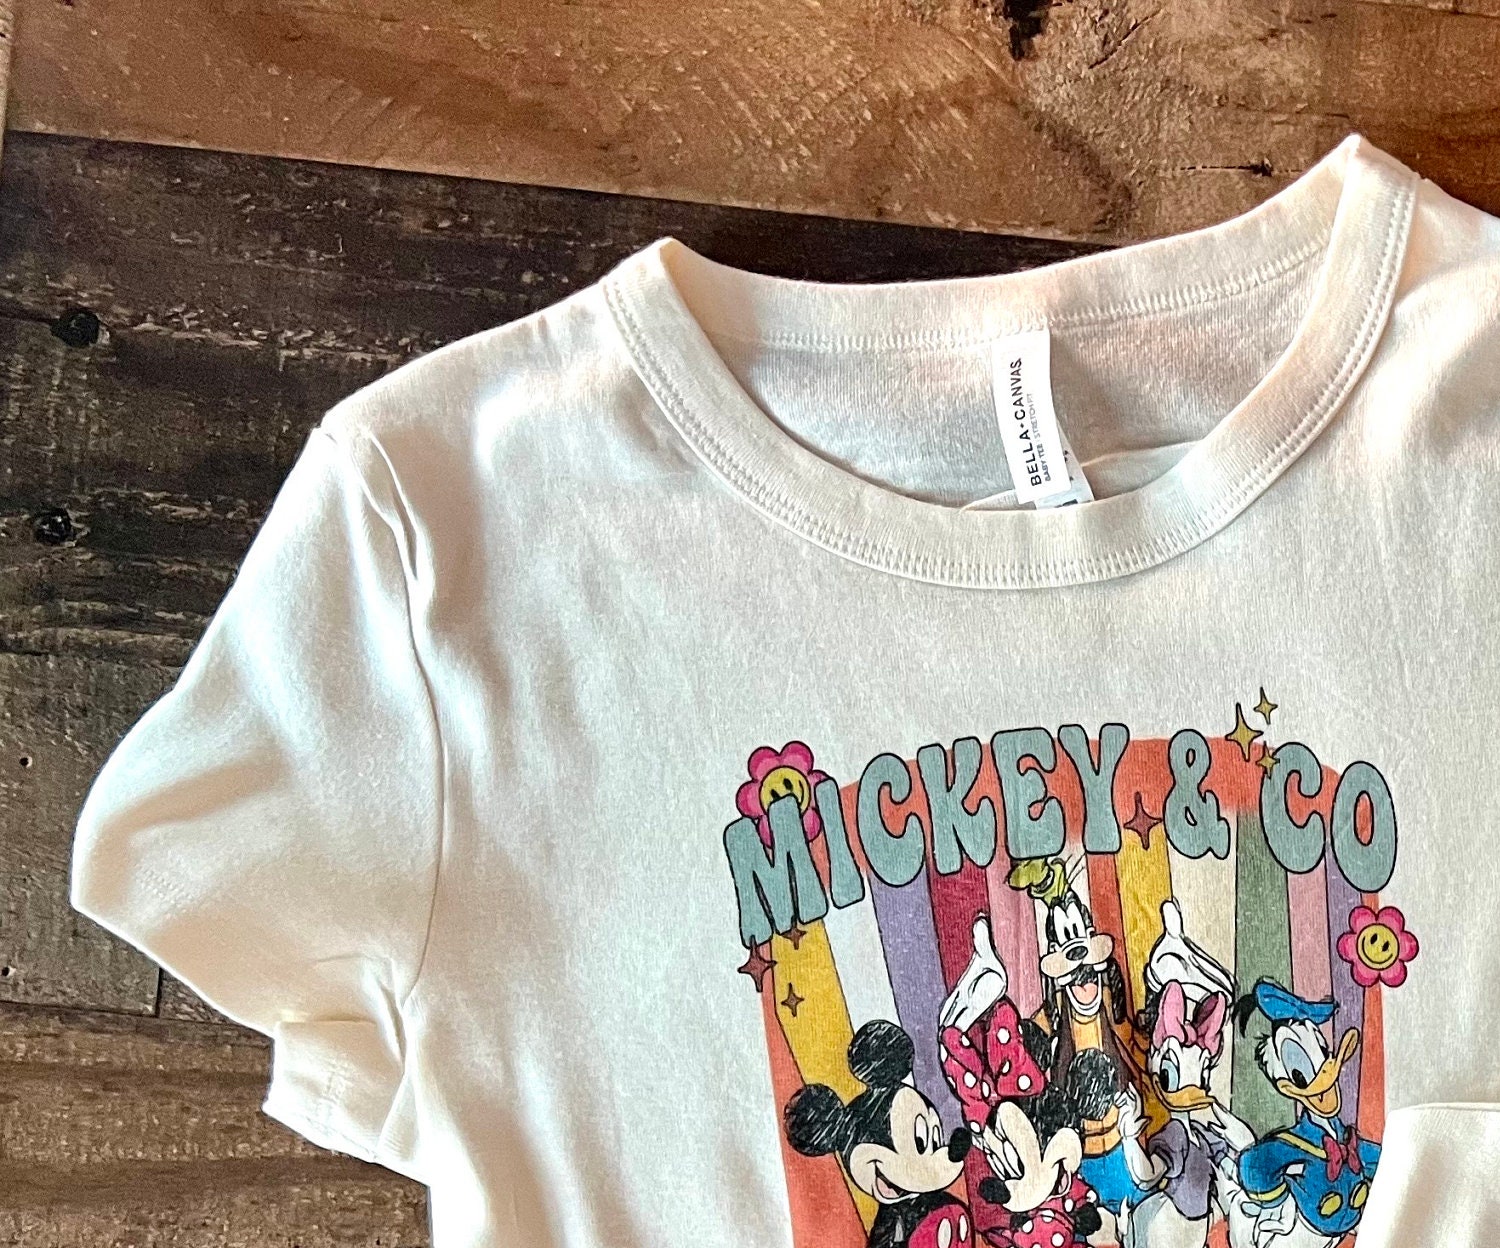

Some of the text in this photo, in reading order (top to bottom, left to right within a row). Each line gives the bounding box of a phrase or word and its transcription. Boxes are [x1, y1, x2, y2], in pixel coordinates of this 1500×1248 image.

[722, 723, 1398, 949] MICKEY & CO
